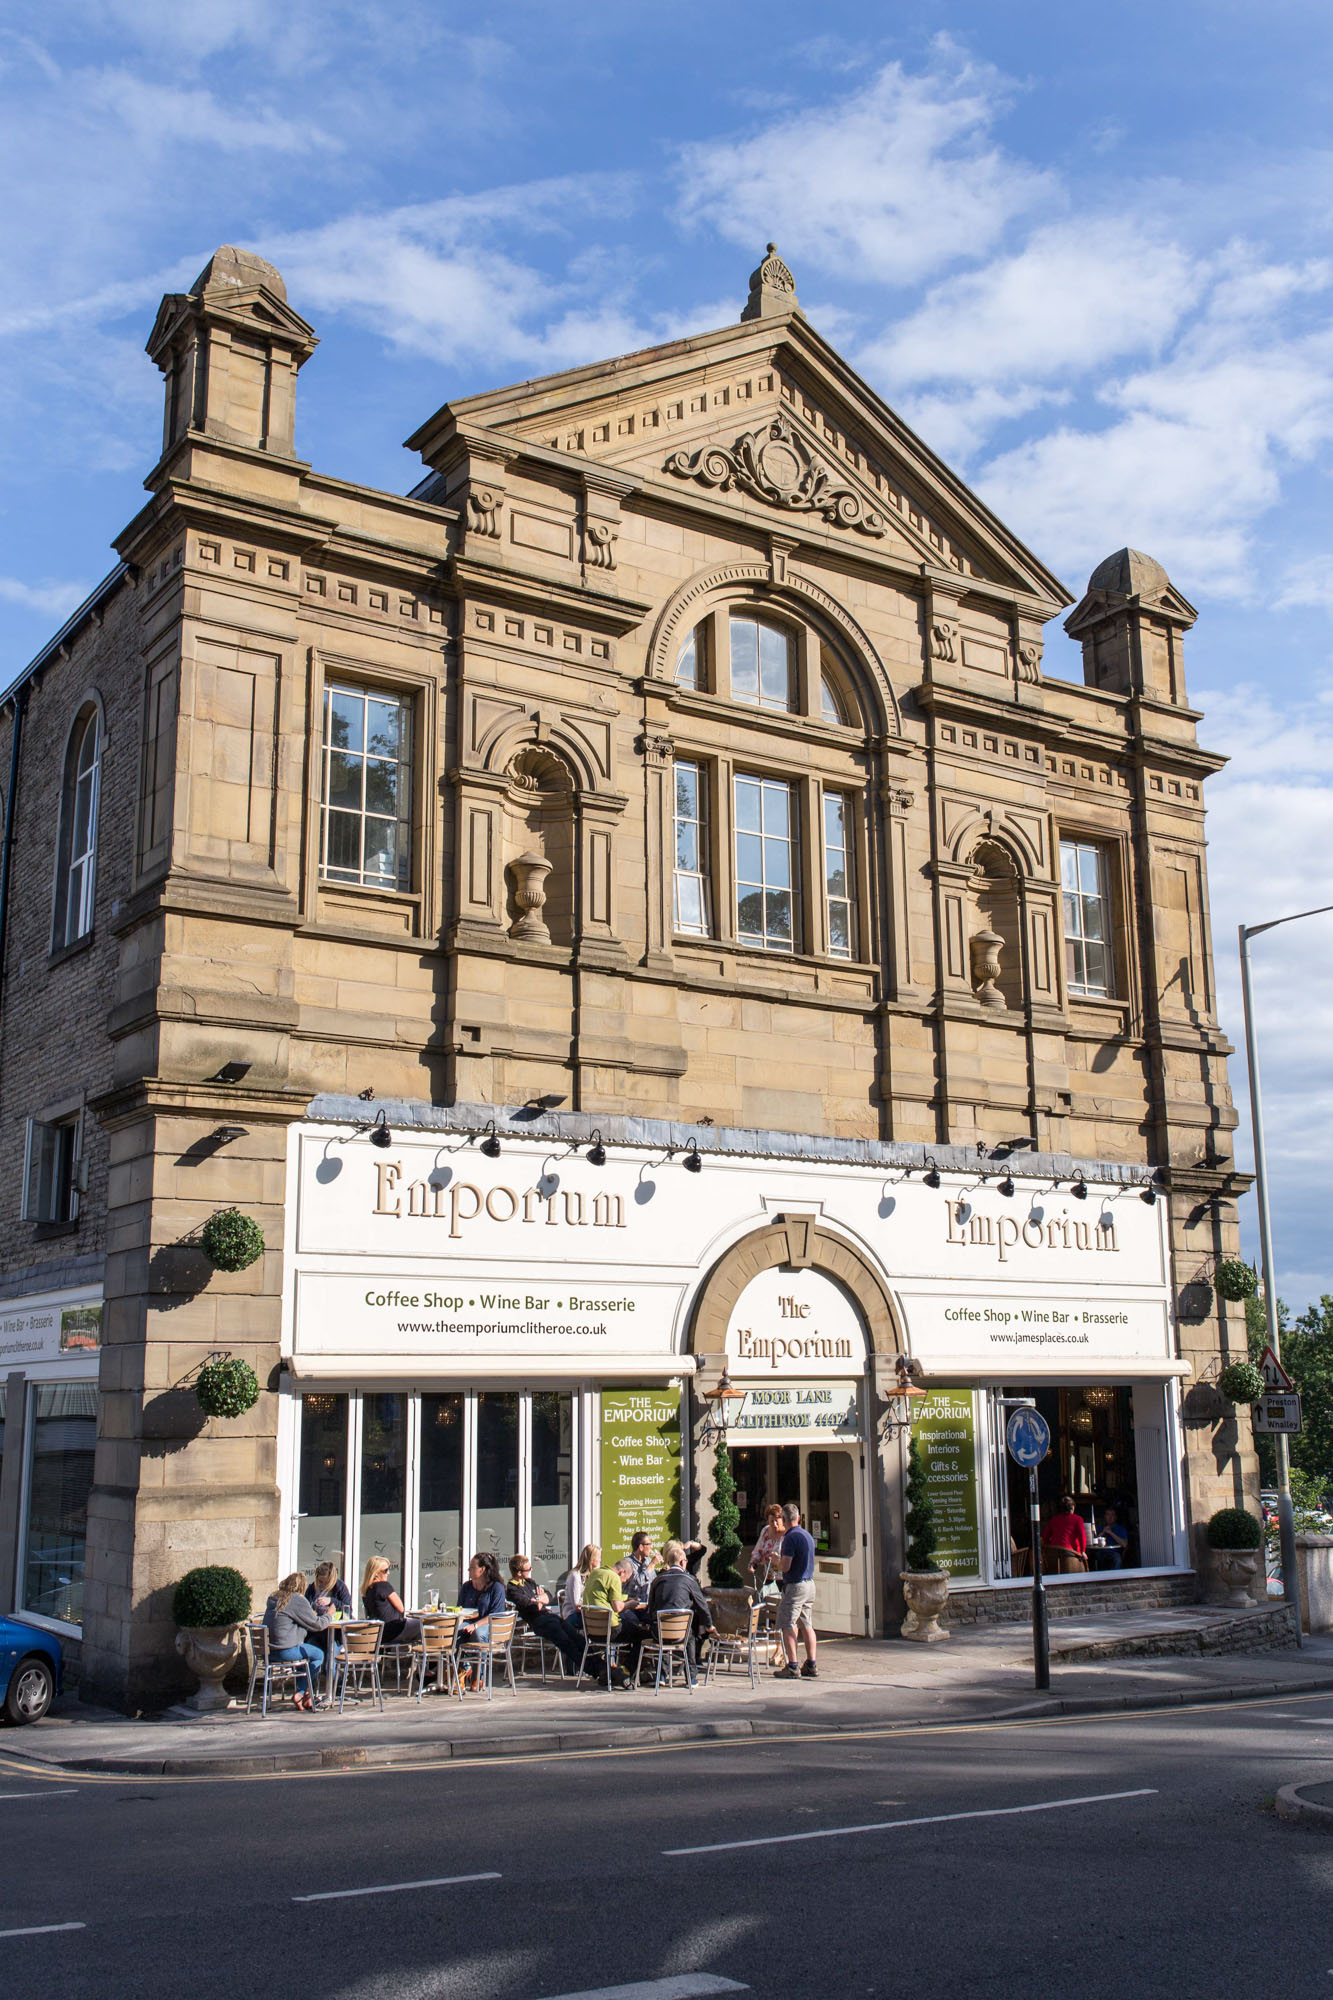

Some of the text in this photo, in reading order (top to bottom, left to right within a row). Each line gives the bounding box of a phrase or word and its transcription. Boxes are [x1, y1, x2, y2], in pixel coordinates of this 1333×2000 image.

[371, 1160, 627, 1238] Emporium
[945, 1198, 1120, 1262] Emporium
[365, 1291, 636, 1313] Coffee Shop Wine Bar Brasserie
[778, 1295, 812, 1319] The
[944, 1308, 1129, 1327] Coffee Shop Wine Bar Brasserie
[397, 1320, 607, 1338] www.theemporiumclitheroe.co.uk
[989, 1331, 1090, 1346] www.jamesplaces.co.uk
[737, 1327, 853, 1368] Emporium
[629, 1396, 652, 1408] THE
[751, 1389, 832, 1405] MOOR LANE
[932, 1396, 951, 1407] THE
[1267, 1398, 1297, 1406] Preston
[604, 1408, 678, 1423] EMPORIUM
[913, 1407, 972, 1420] EMPORIUM
[737, 1413, 811, 1429] CLITHEROE
[1267, 1420, 1298, 1430] Whalley
[611, 1434, 671, 1449] Coffee Shop
[920, 1429, 967, 1442] Inspirational
[927, 1443, 960, 1454] Interiors
[619, 1454, 664, 1466] Wine Bar
[930, 1460, 959, 1472] Gifts &
[618, 1472, 665, 1486] Brasserie
[927, 1471, 969, 1483] ccessories
[618, 1499, 644, 1507] Opening
[936, 1559, 953, 1568] 1200
